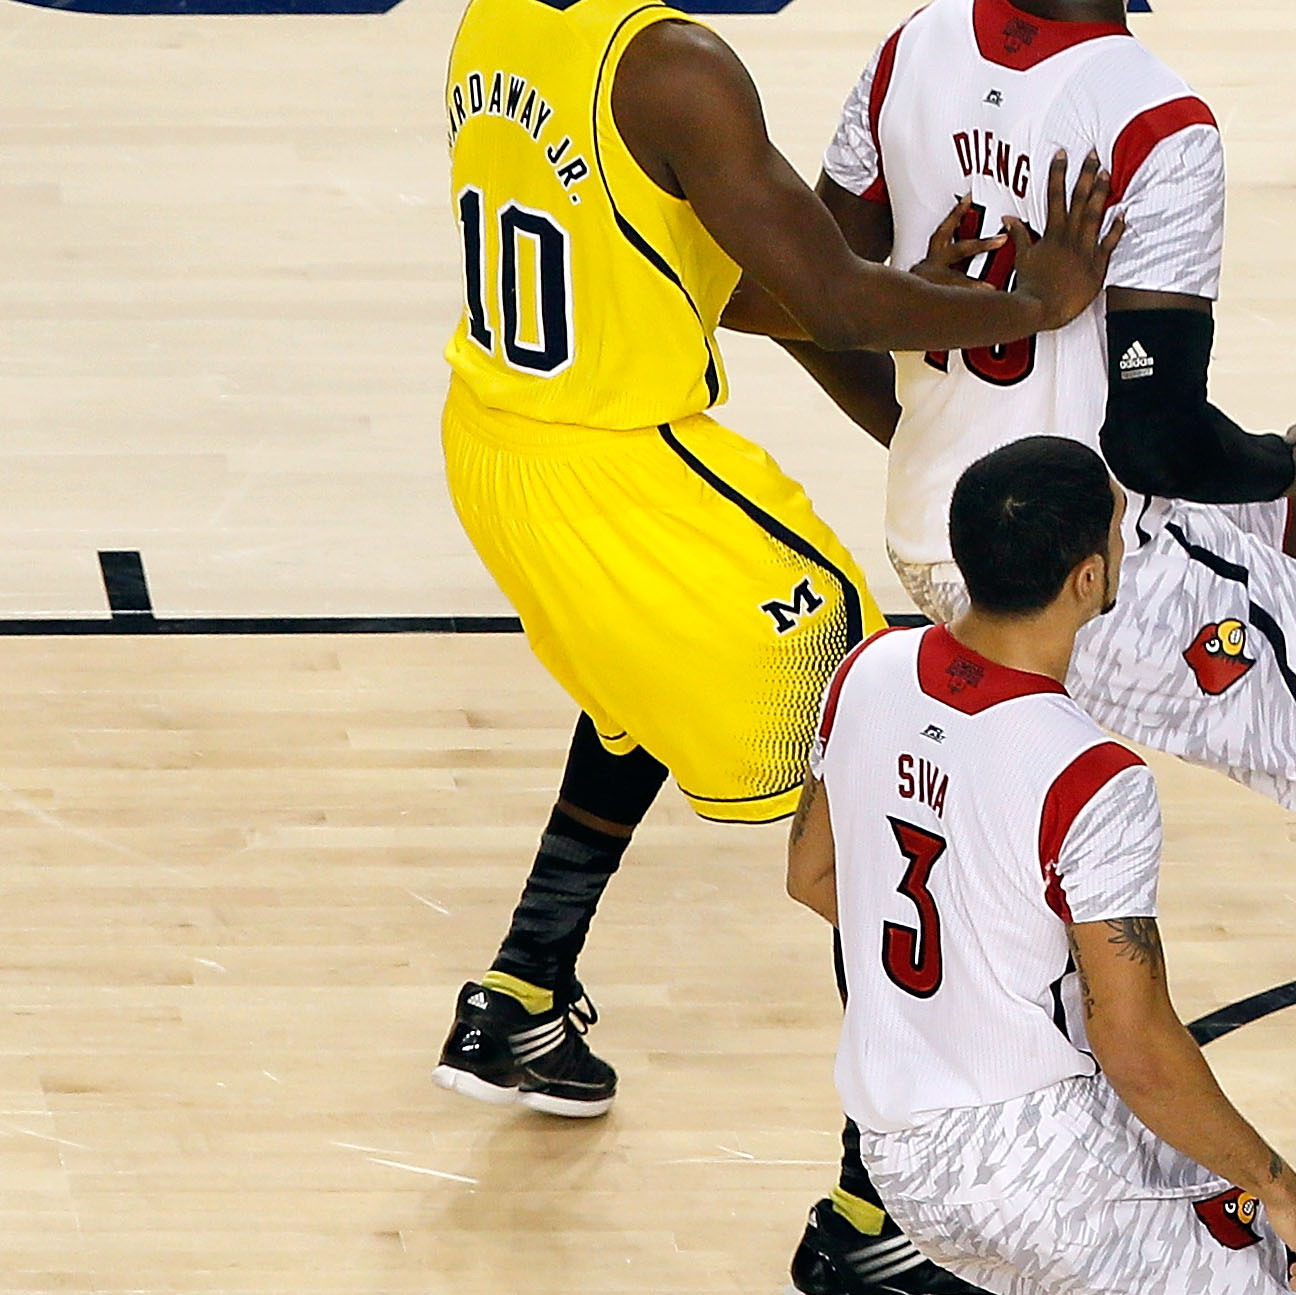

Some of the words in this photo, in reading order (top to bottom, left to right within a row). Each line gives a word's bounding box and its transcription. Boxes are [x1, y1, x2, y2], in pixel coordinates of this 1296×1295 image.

[546, 137, 589, 204] JR.
[952, 128, 1031, 200] DIENG
[456, 186, 573, 375] 10
[760, 577, 825, 635] M
[898, 754, 949, 819] SIVA
[881, 814, 947, 999] 3
